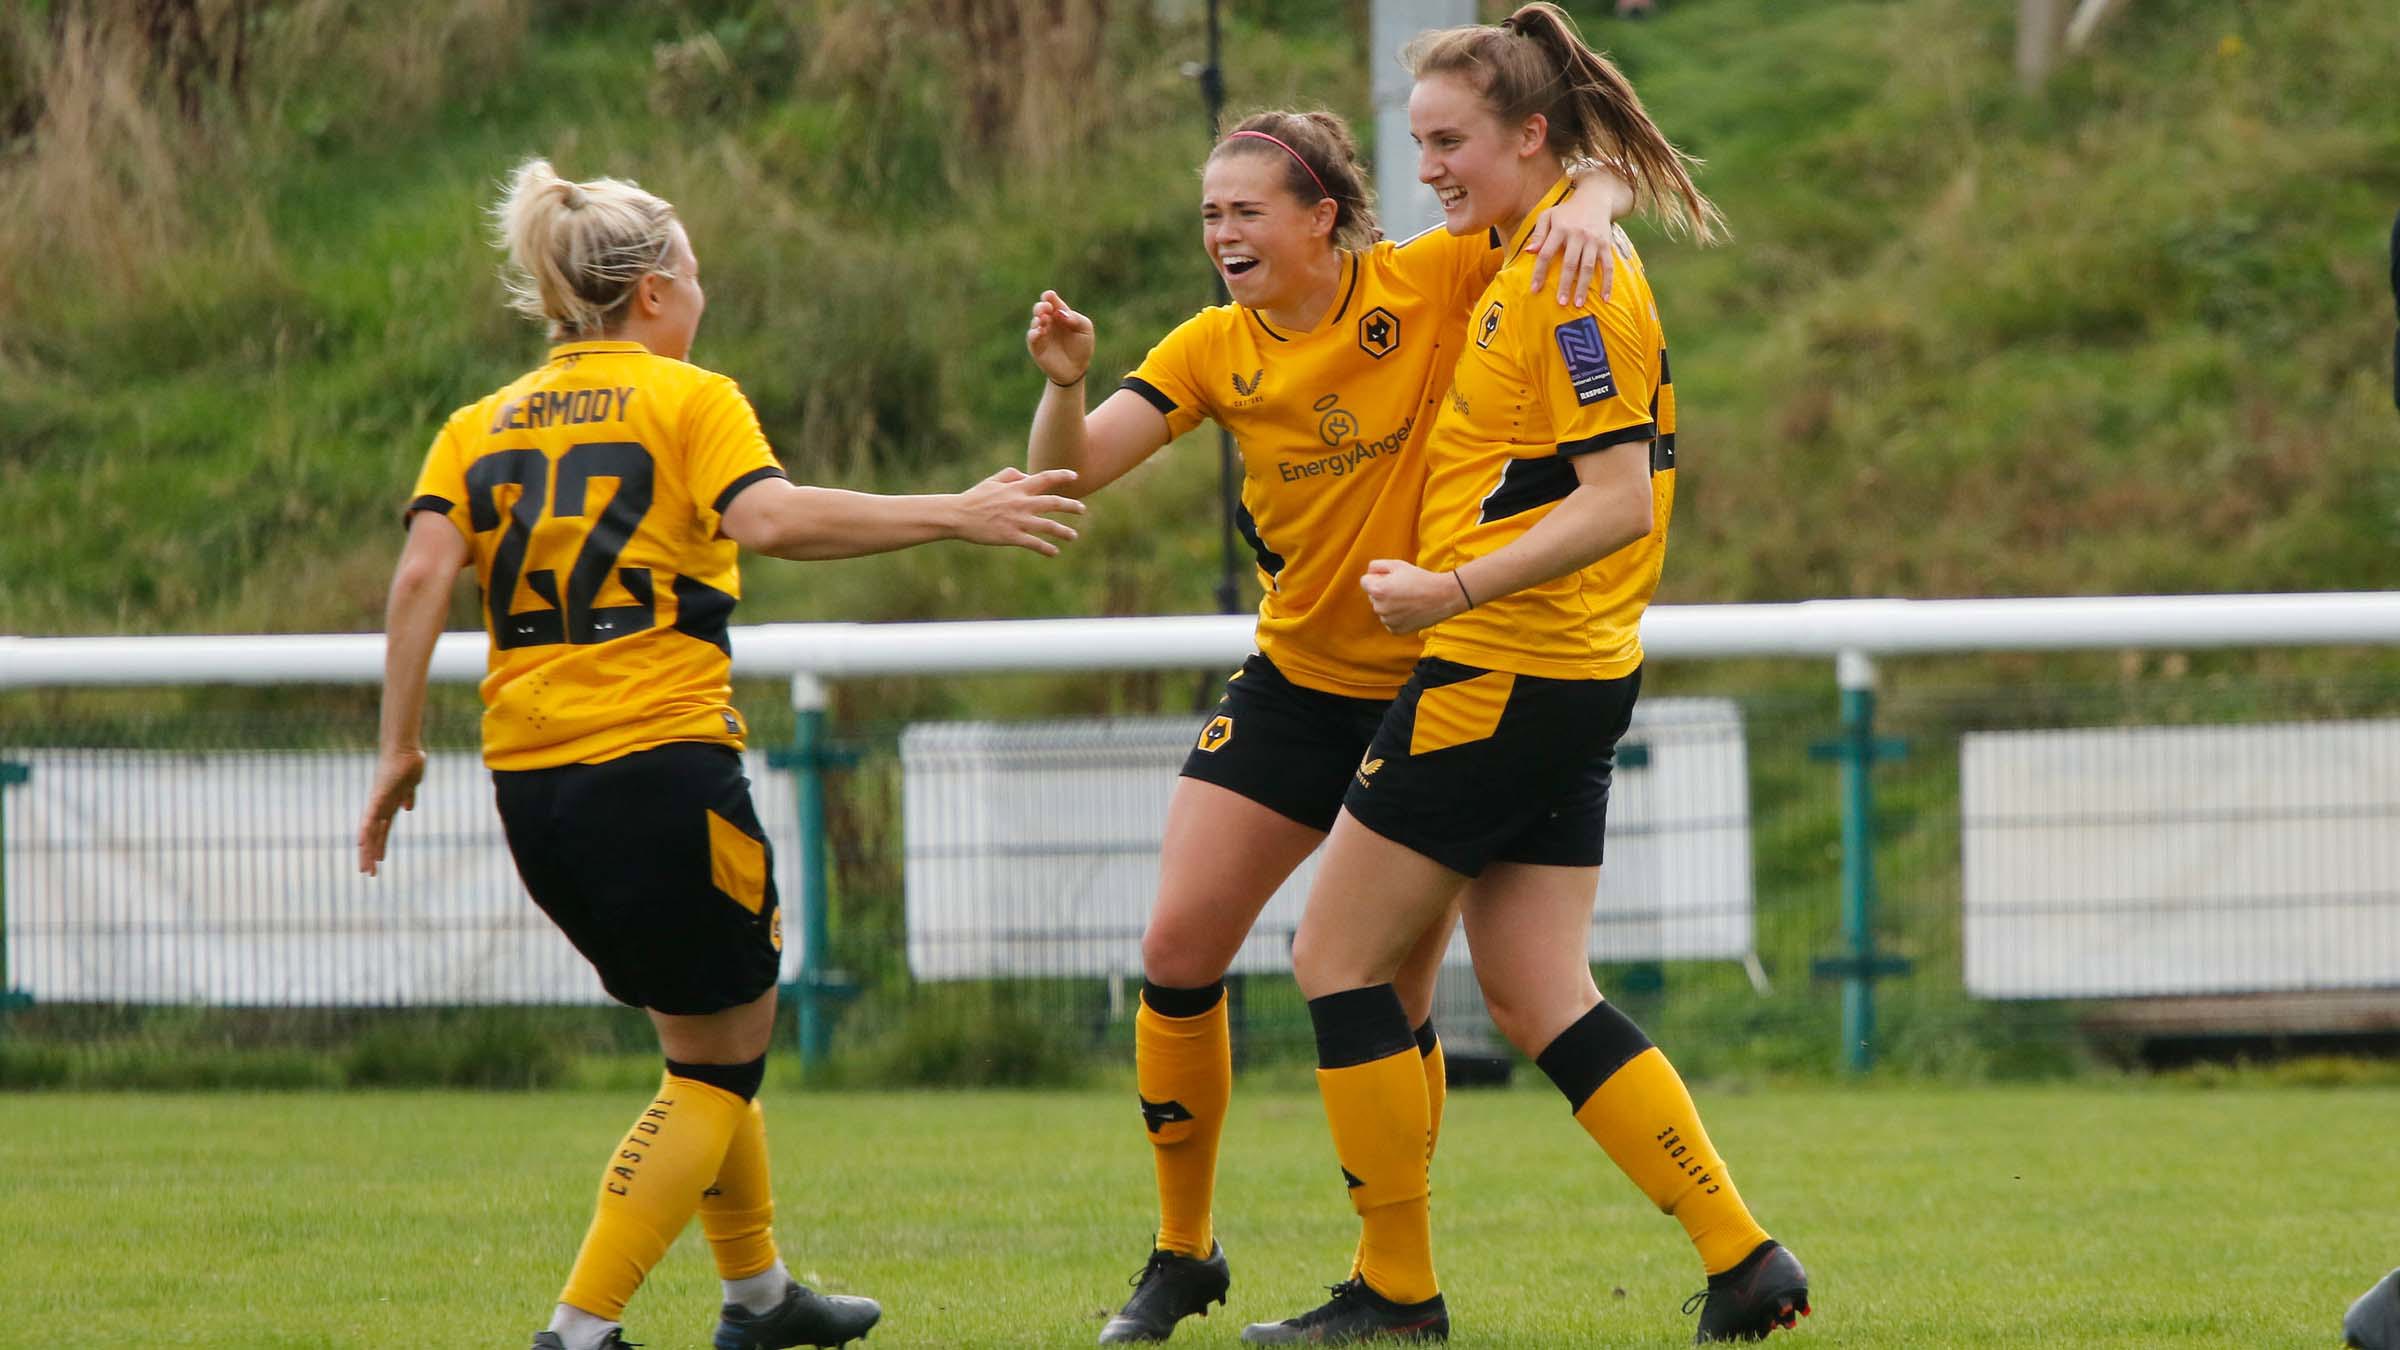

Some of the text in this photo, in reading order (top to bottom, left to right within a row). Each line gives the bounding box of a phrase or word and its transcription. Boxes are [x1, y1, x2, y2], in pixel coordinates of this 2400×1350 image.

[1573, 376, 1592, 387] ational
[1580, 386, 1609, 400] RESPECT
[466, 442, 654, 650] 22
[1657, 1126, 1720, 1195] CASTORE
